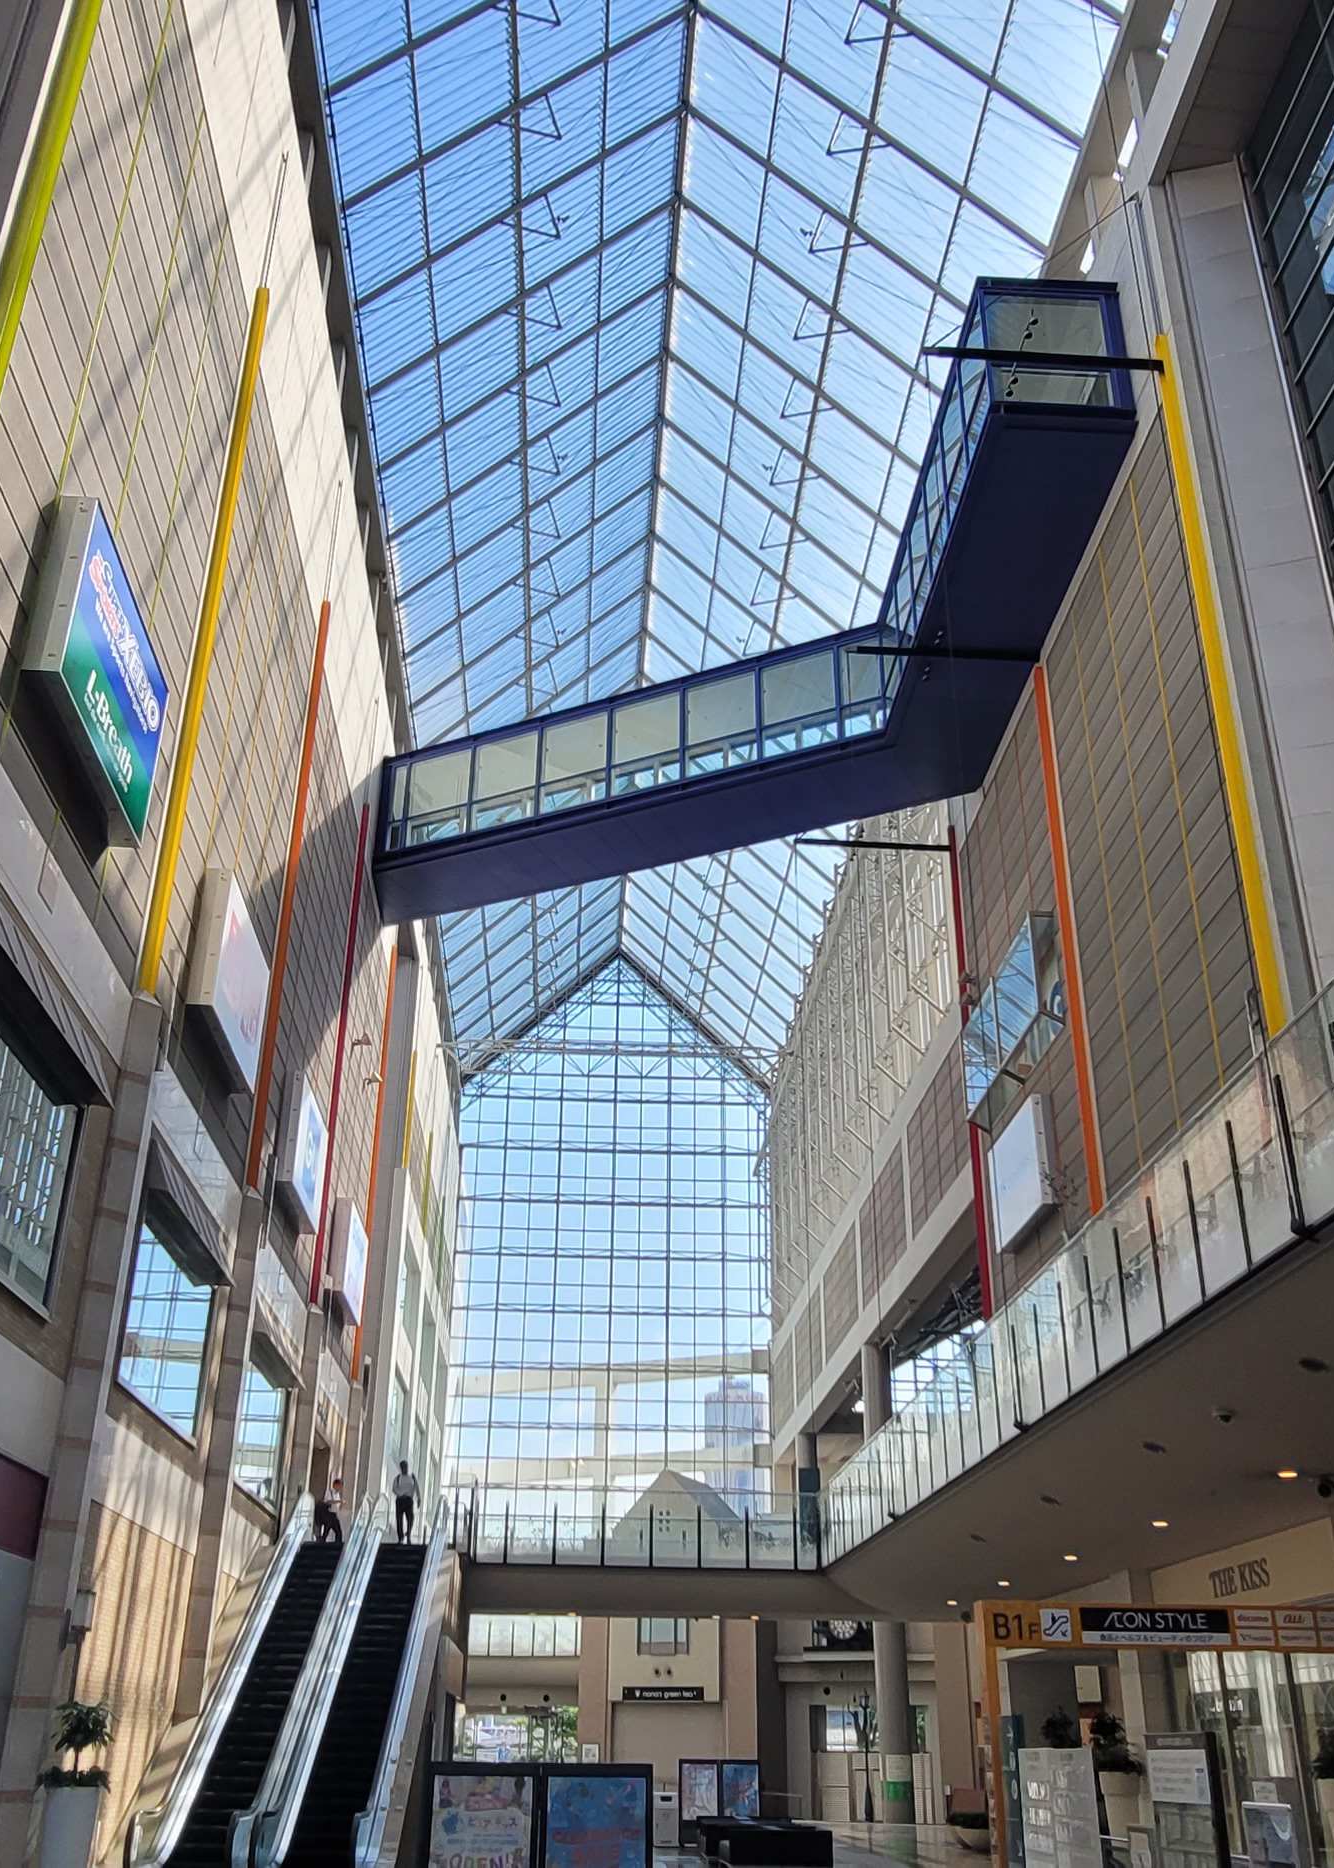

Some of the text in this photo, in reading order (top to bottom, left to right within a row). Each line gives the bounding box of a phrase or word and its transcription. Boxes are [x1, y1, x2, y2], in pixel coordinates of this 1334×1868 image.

[115, 633, 160, 732] XEBIO
[1209, 1558, 1270, 1598] THE KISS
[1155, 1612, 1209, 1630] STYLE
